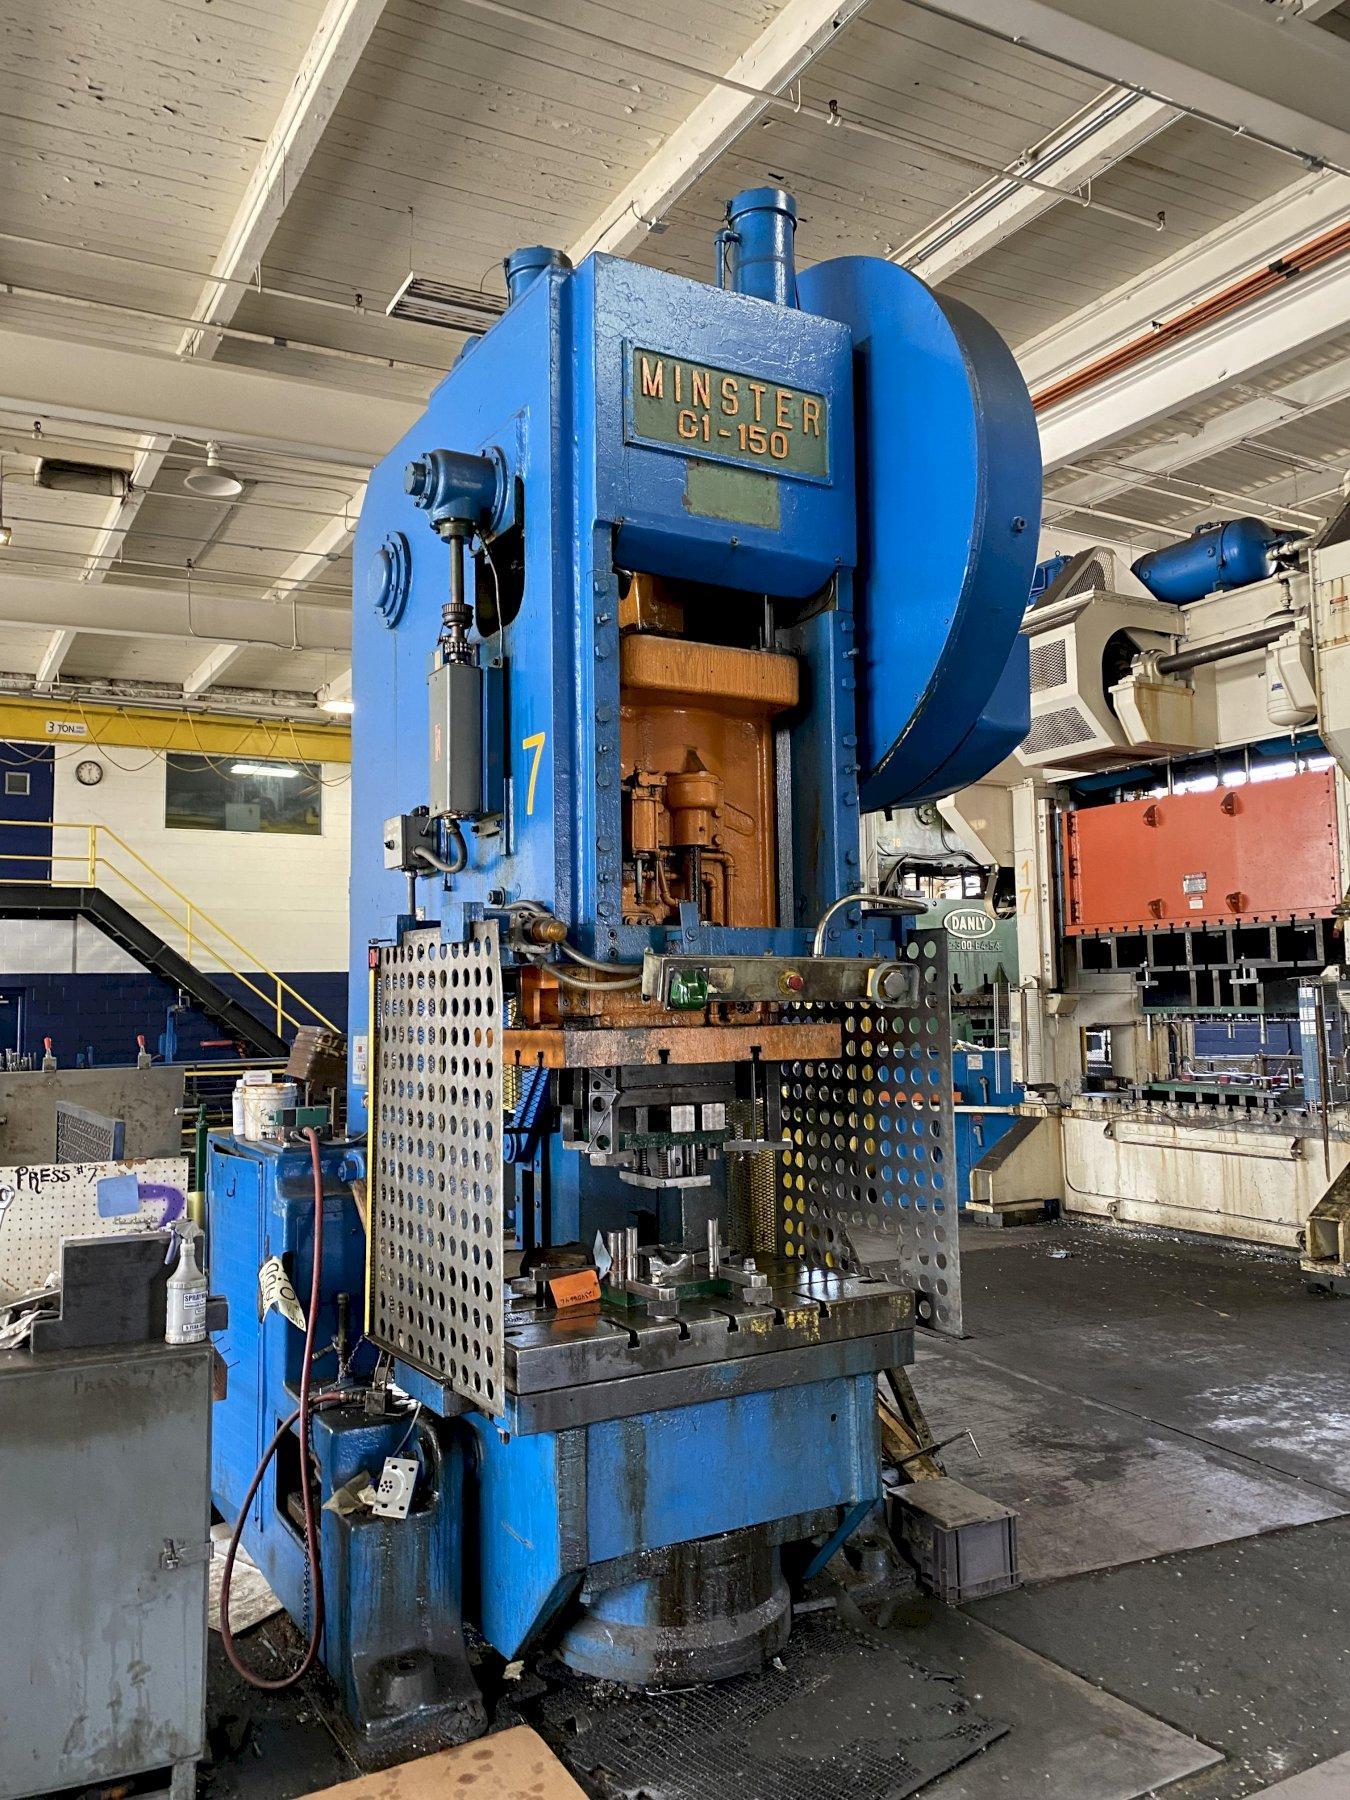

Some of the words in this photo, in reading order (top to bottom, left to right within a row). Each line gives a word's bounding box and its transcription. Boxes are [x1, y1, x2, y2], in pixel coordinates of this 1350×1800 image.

[641, 357, 820, 437] MINSTER
[48, 721, 54, 733] 3
[57, 724, 75, 733] TON
[523, 732, 546, 815] 7
[952, 916, 987, 931] DANLY
[15, 1166, 71, 1194] PRESS
